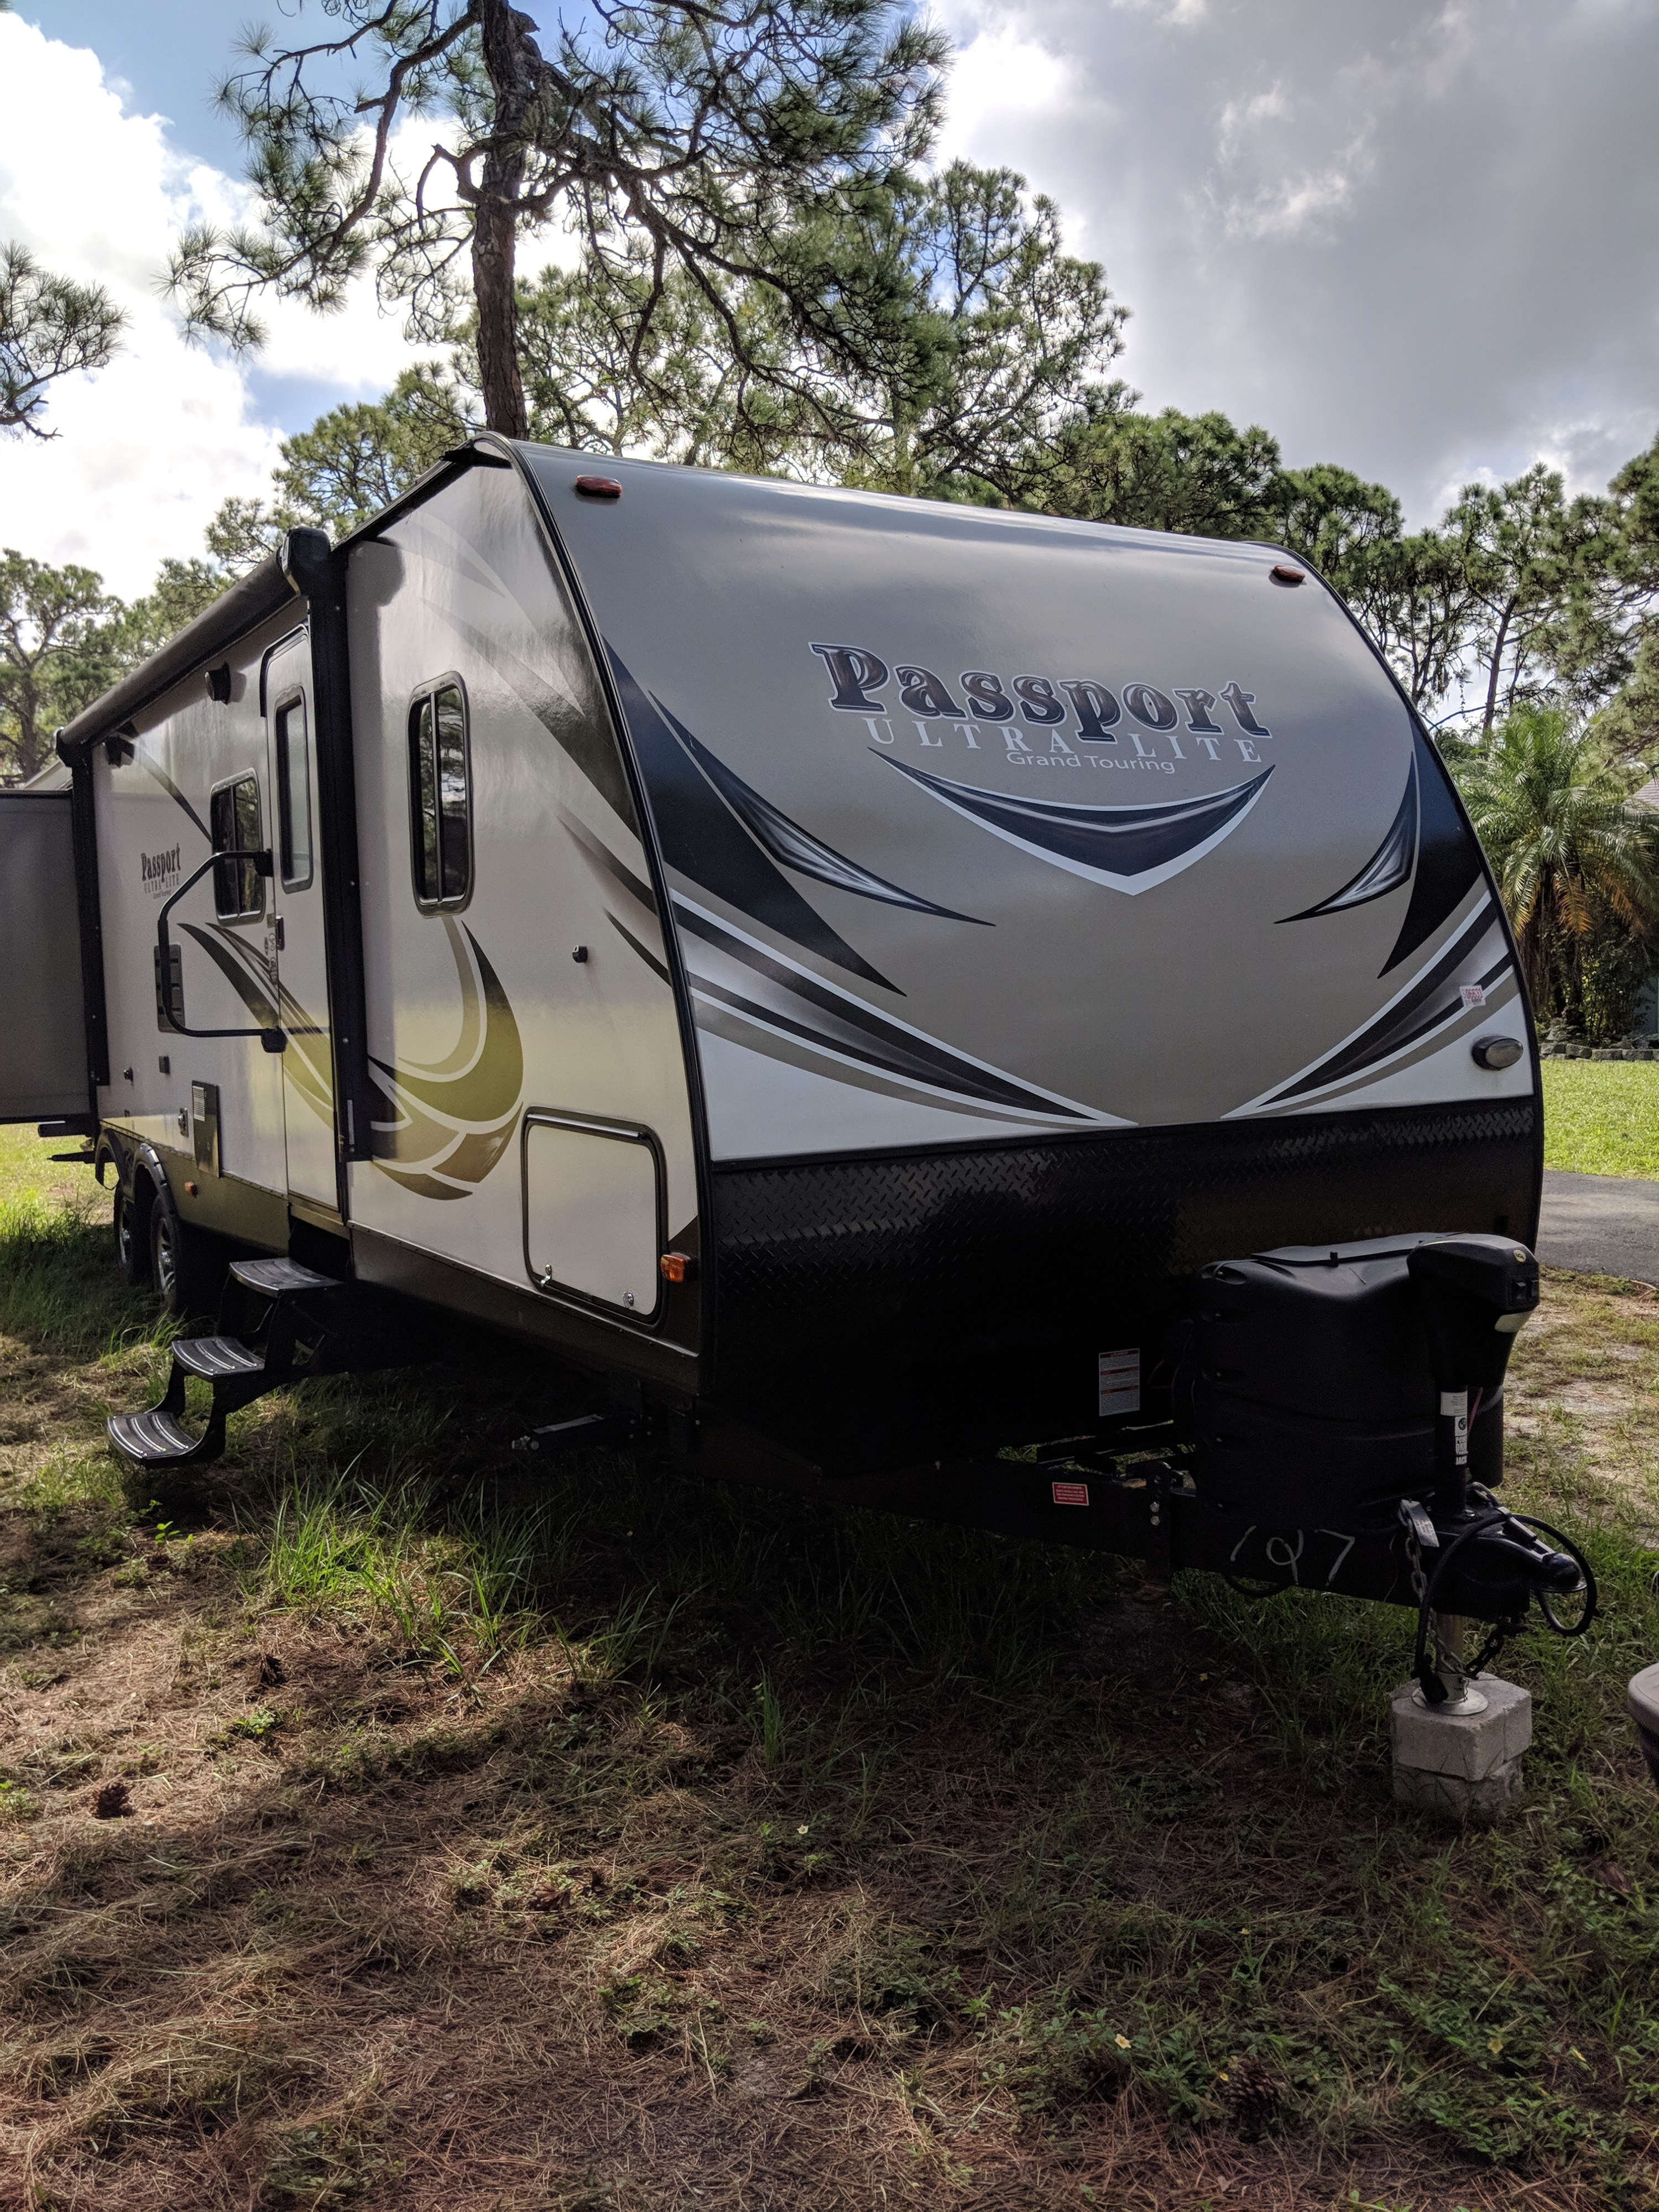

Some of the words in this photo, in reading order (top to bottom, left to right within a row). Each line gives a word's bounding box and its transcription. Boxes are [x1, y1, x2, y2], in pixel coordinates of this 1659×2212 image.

[808, 641, 1272, 744] Passport
[862, 717, 1074, 754] ULTRA
[1126, 733, 1262, 763] LITE
[1006, 751, 1081, 769] Grand
[1084, 754, 1176, 774] Touring
[141, 842, 181, 883] Passport
